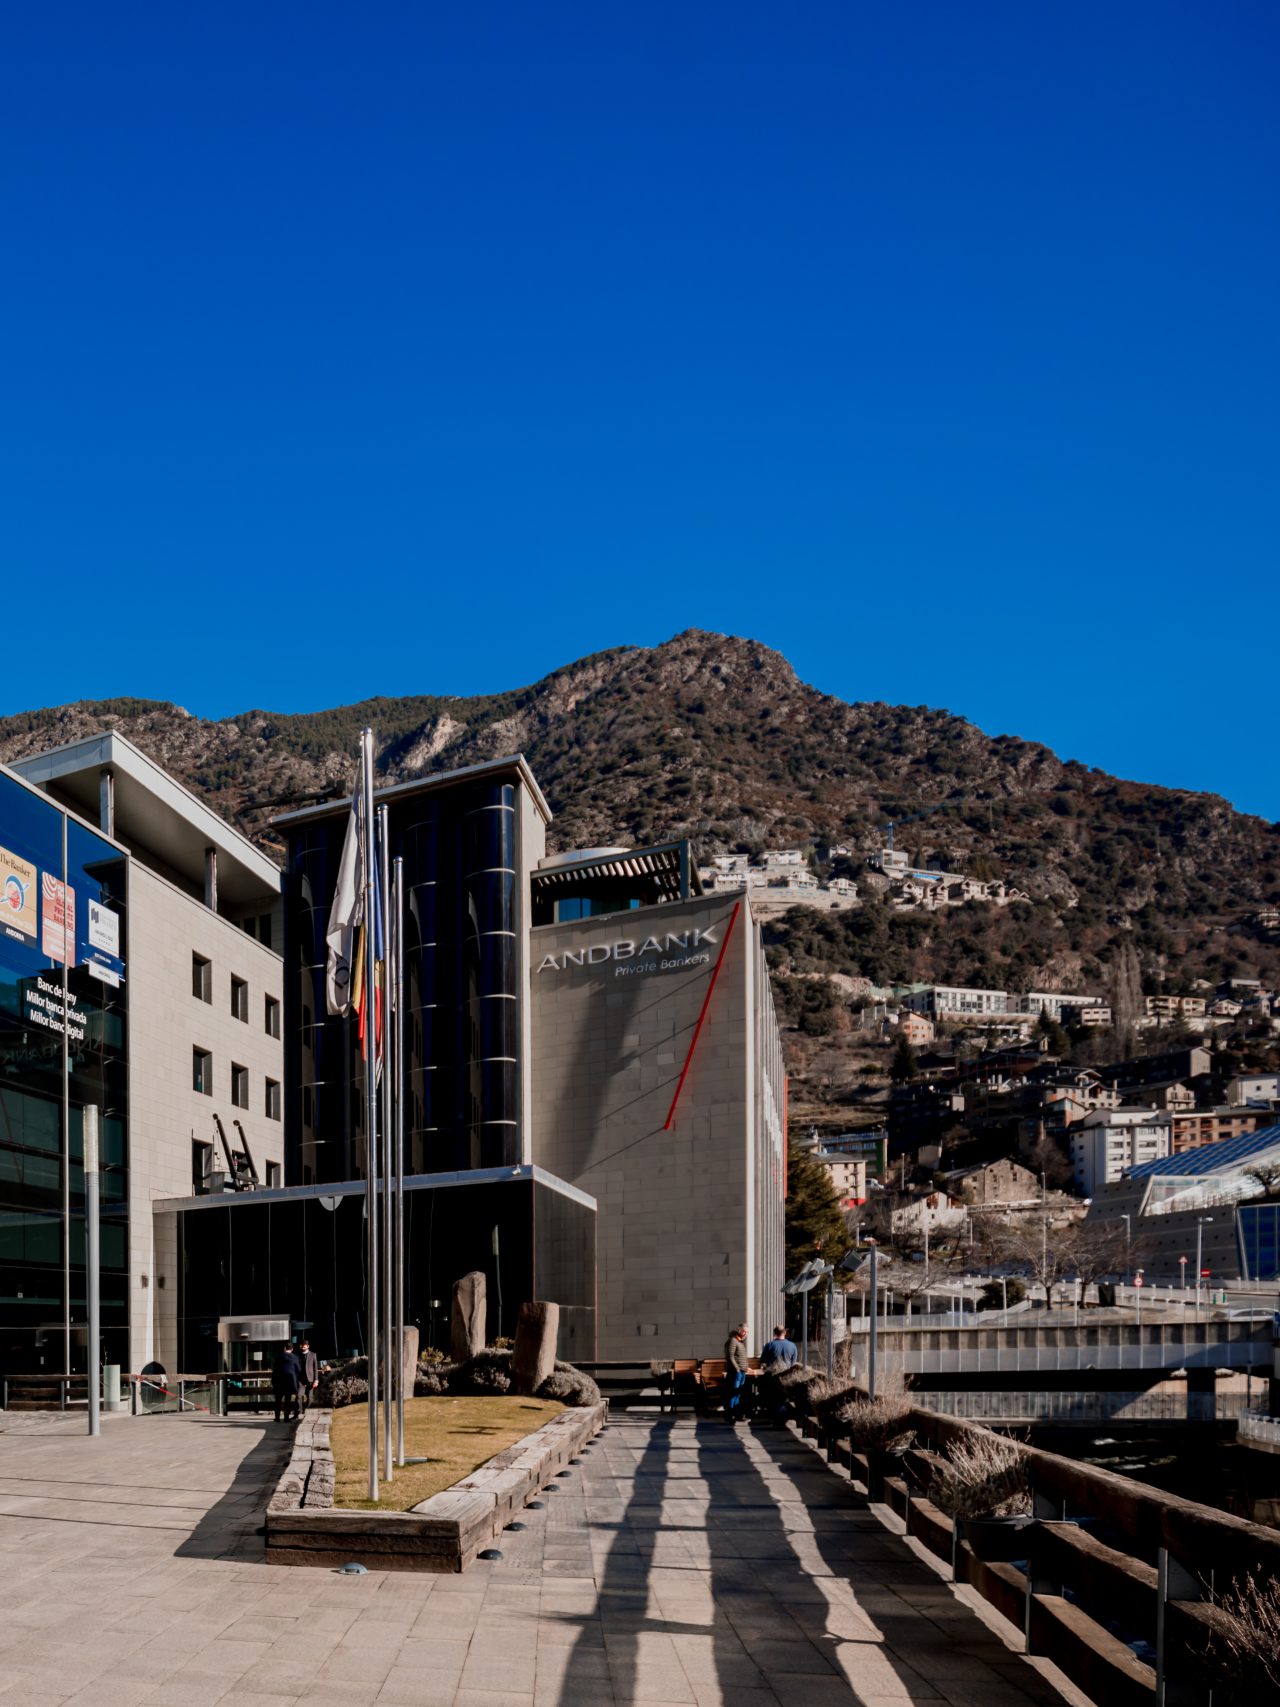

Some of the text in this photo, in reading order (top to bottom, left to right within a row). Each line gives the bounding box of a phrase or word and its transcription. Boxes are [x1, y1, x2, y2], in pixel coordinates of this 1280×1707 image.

[0, 853, 31, 878] The Banker
[536, 925, 718, 974] ANDBANK
[615, 953, 710, 977] Private Bankers
[37, 976, 53, 994] Banc
[54, 985, 62, 998] de
[26, 990, 45, 1008] Millor
[46, 997, 65, 1015] banca
[30, 1009, 49, 1027] Millor
[49, 1017, 65, 1033] banc
